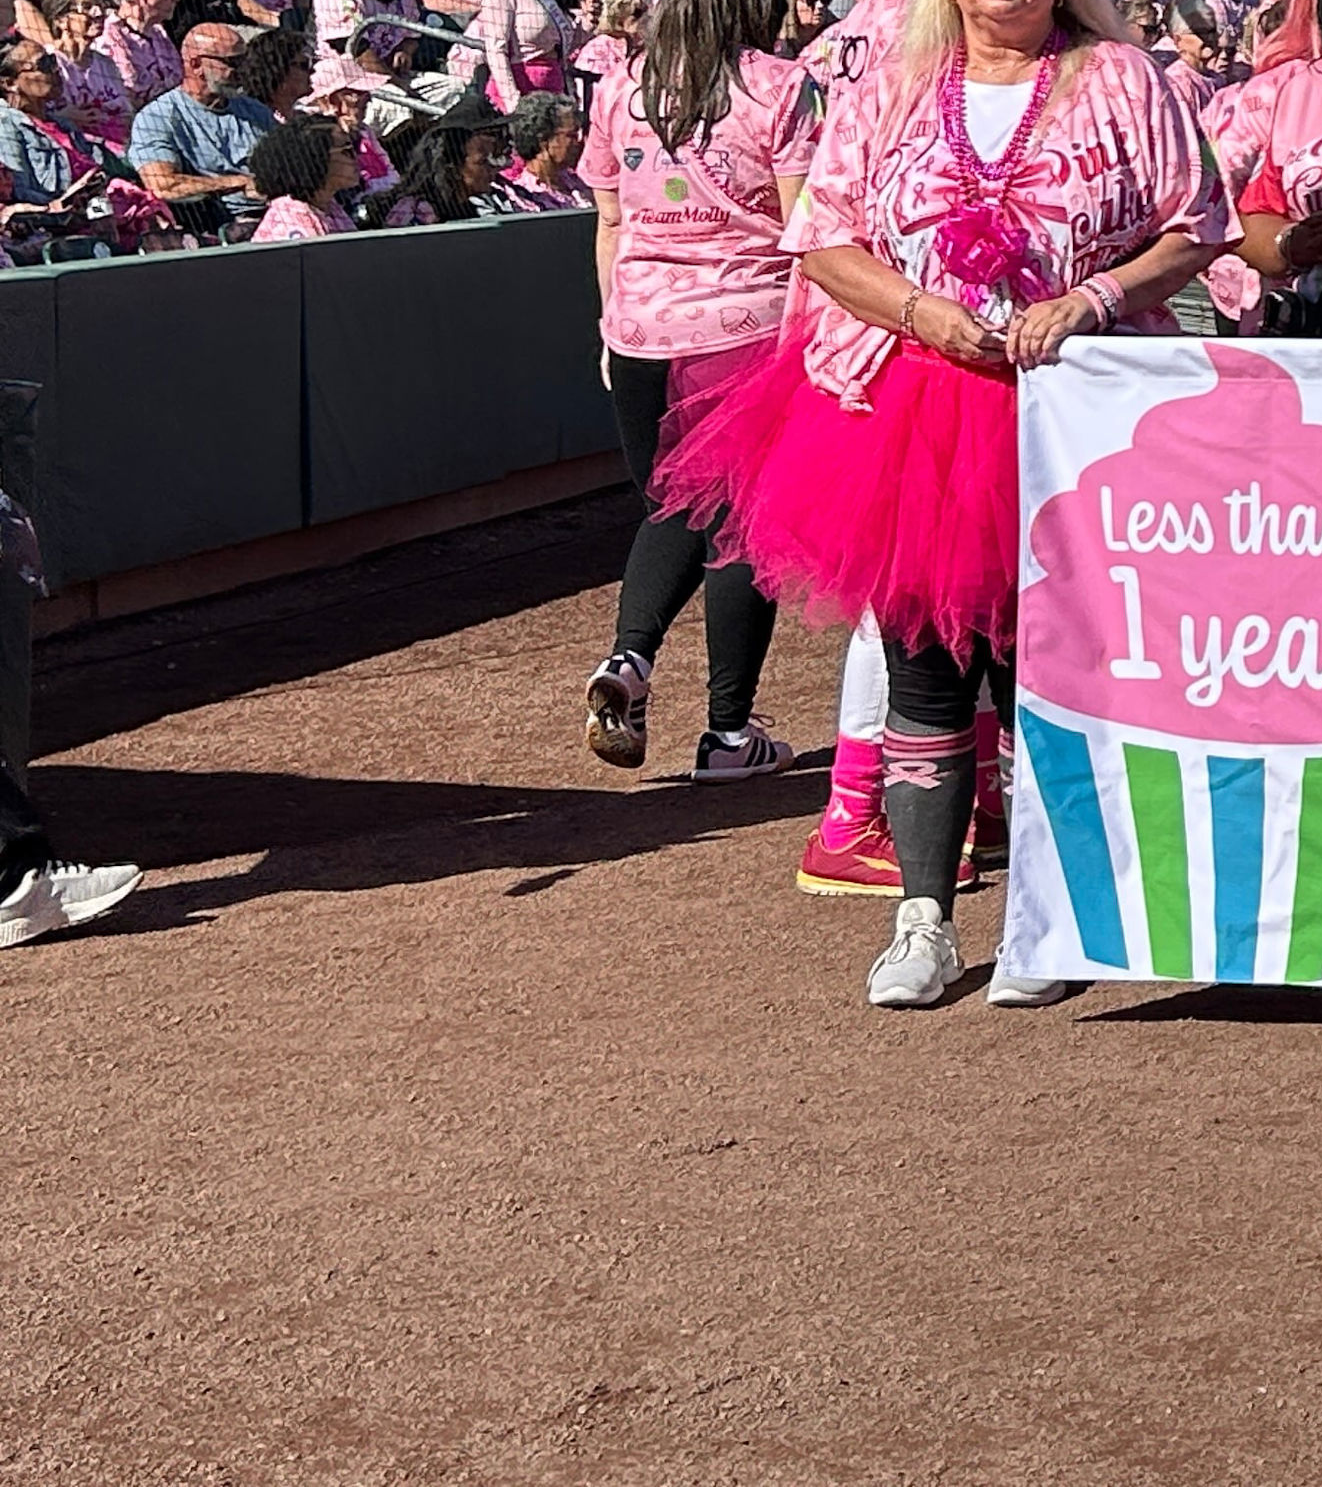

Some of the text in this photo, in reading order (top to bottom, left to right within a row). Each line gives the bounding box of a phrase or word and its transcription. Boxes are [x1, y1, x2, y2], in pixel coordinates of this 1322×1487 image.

[630, 206, 731, 226] #TeamMolly
[1100, 485, 1214, 553] Less
[1109, 565, 1162, 679] 1
